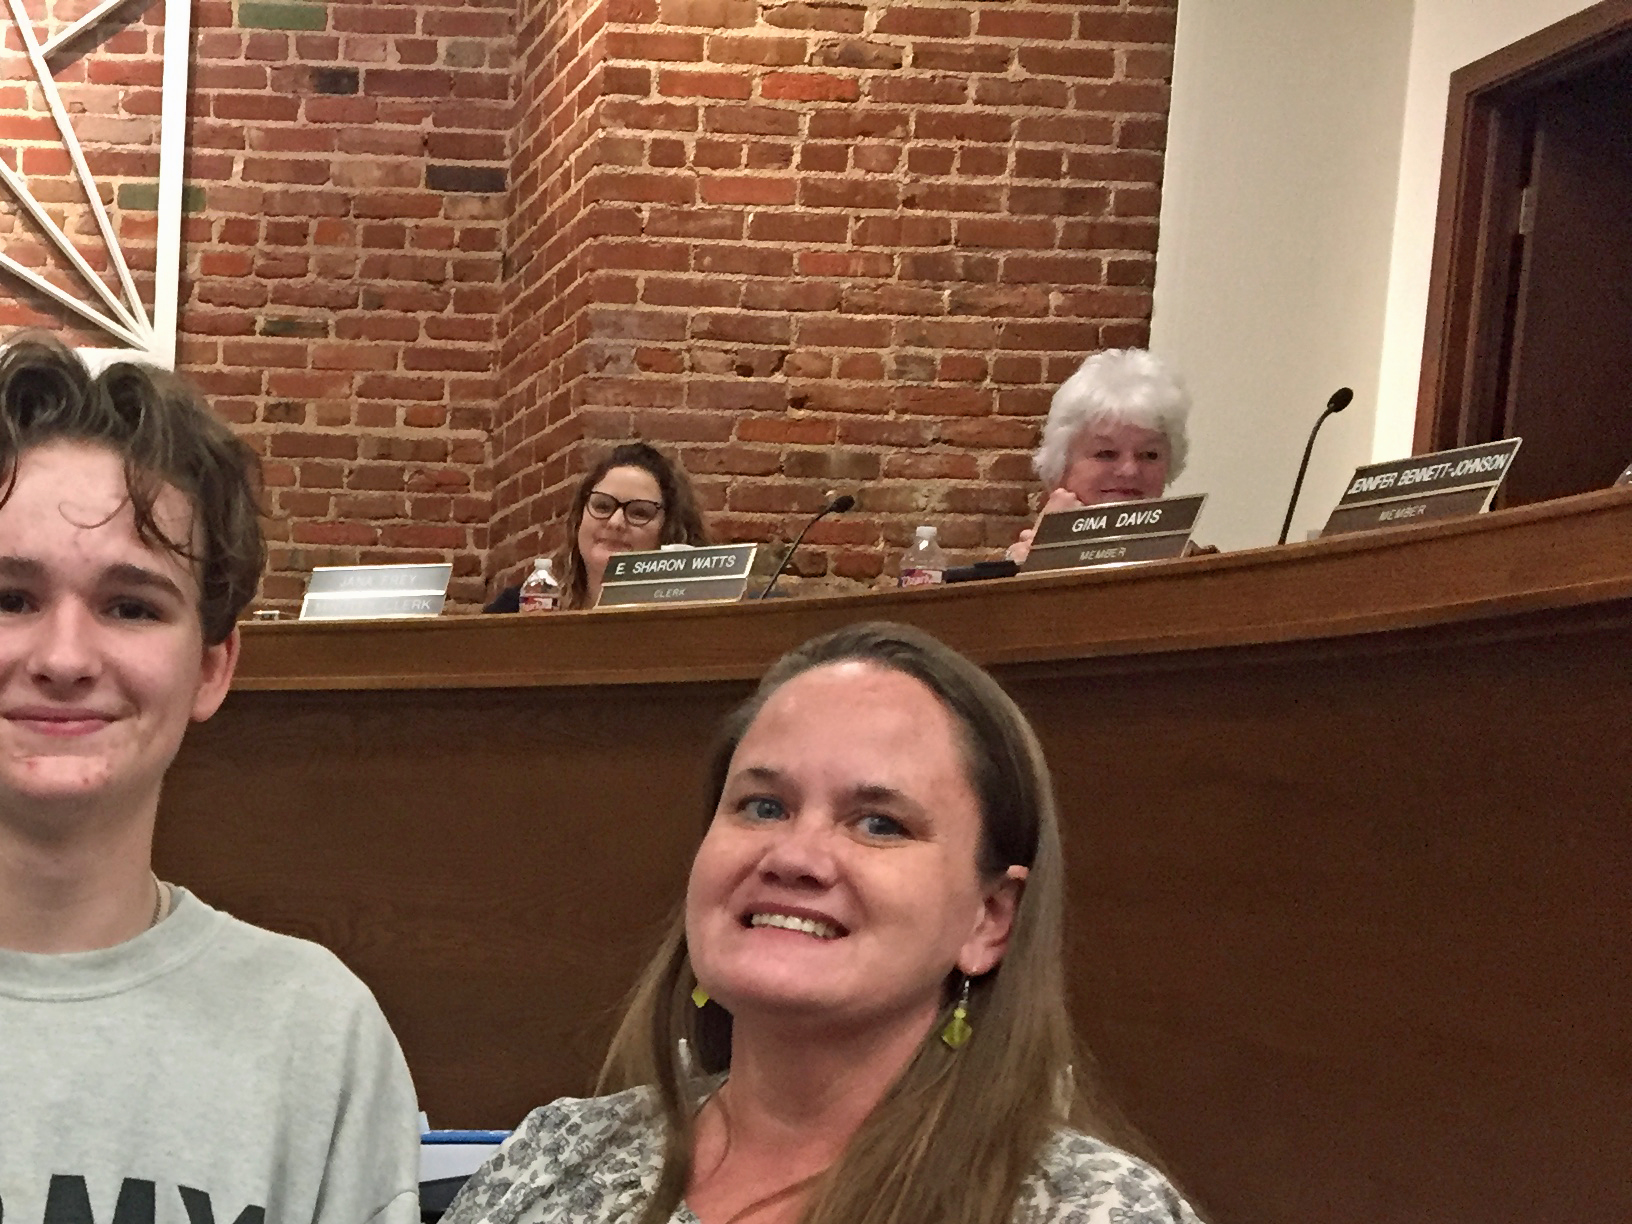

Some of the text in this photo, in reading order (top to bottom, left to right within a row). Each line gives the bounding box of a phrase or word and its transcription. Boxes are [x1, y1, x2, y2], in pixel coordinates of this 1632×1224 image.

[1347, 453, 1510, 494] JENNIFER BENNETT-JOHNSON
[1072, 508, 1163, 532] GINA DAVIS
[1378, 503, 1427, 521] MEMBER
[1079, 547, 1126, 561] MEMBER
[632, 558, 687, 574] SHARON
[691, 555, 737, 569] WATTS
[653, 588, 686, 599] CLERK
